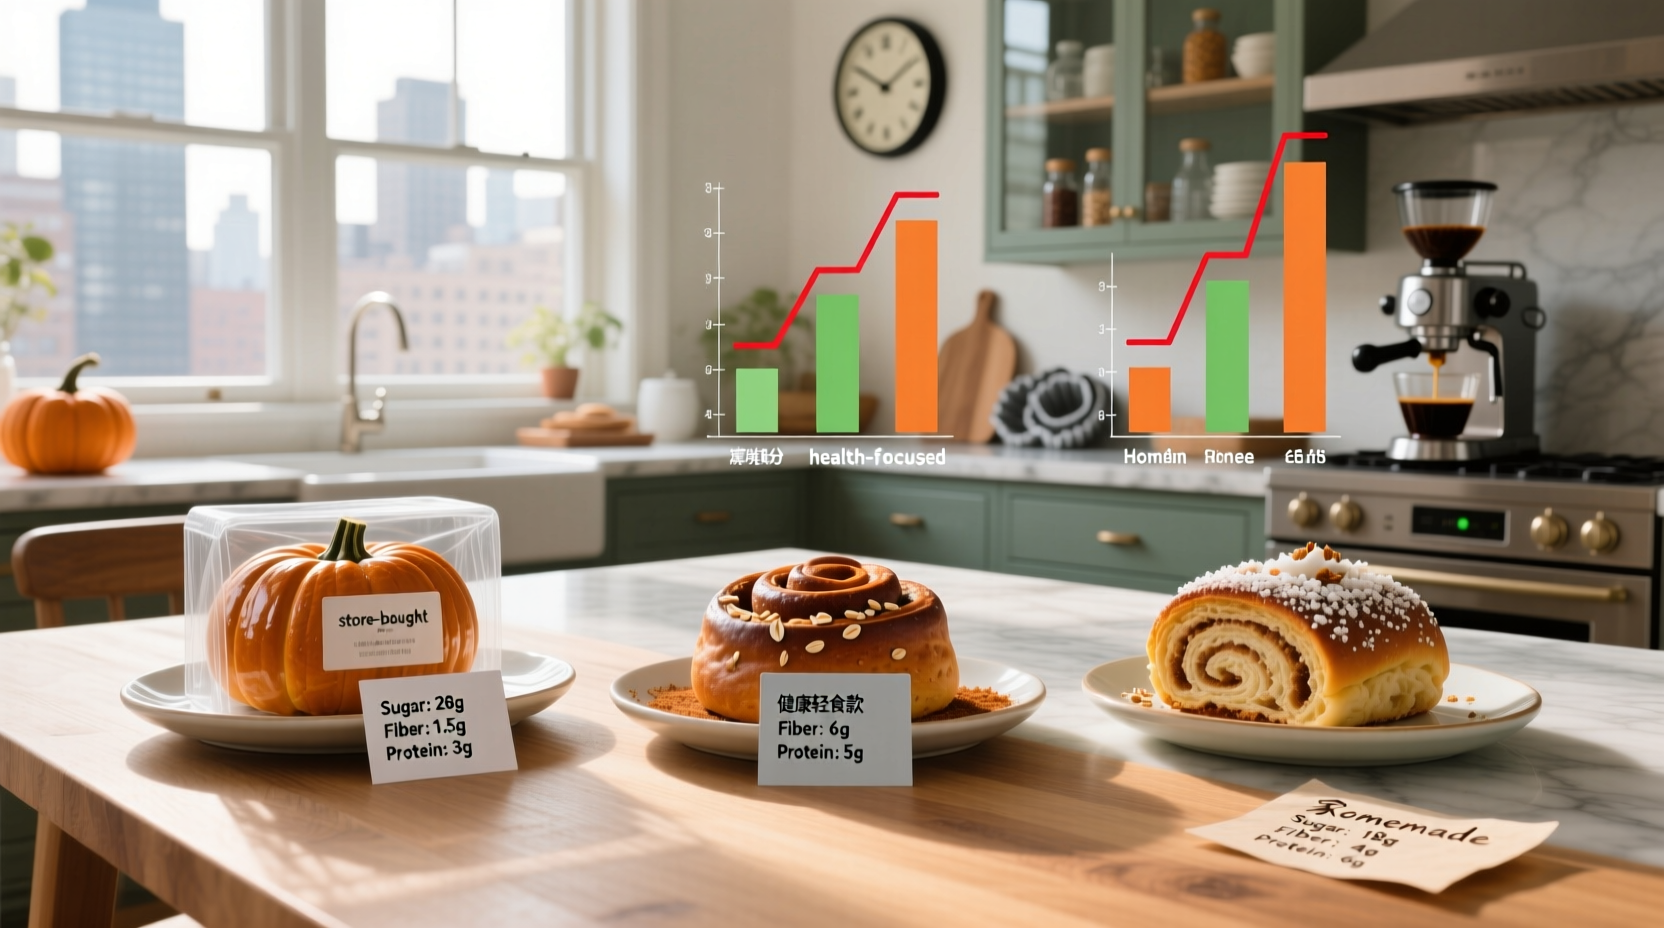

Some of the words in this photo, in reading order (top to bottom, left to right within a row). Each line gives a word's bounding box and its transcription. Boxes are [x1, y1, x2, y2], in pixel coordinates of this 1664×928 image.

[338, 608, 429, 628] store-bought
[380, 700, 431, 718] Sugar:
[777, 693, 864, 715] 健康轻食款
[384, 721, 430, 739] Fiber:
[432, 717, 467, 737] 1.5g
[778, 720, 824, 736] Fiber:
[829, 720, 850, 740] 6g
[386, 742, 449, 761] Protein:
[452, 740, 473, 759] 3g
[777, 743, 840, 760] Protein:
[843, 744, 864, 764] 5g
[1290, 814, 1351, 836] Sugar:
[1274, 825, 1340, 849] Fiber:
